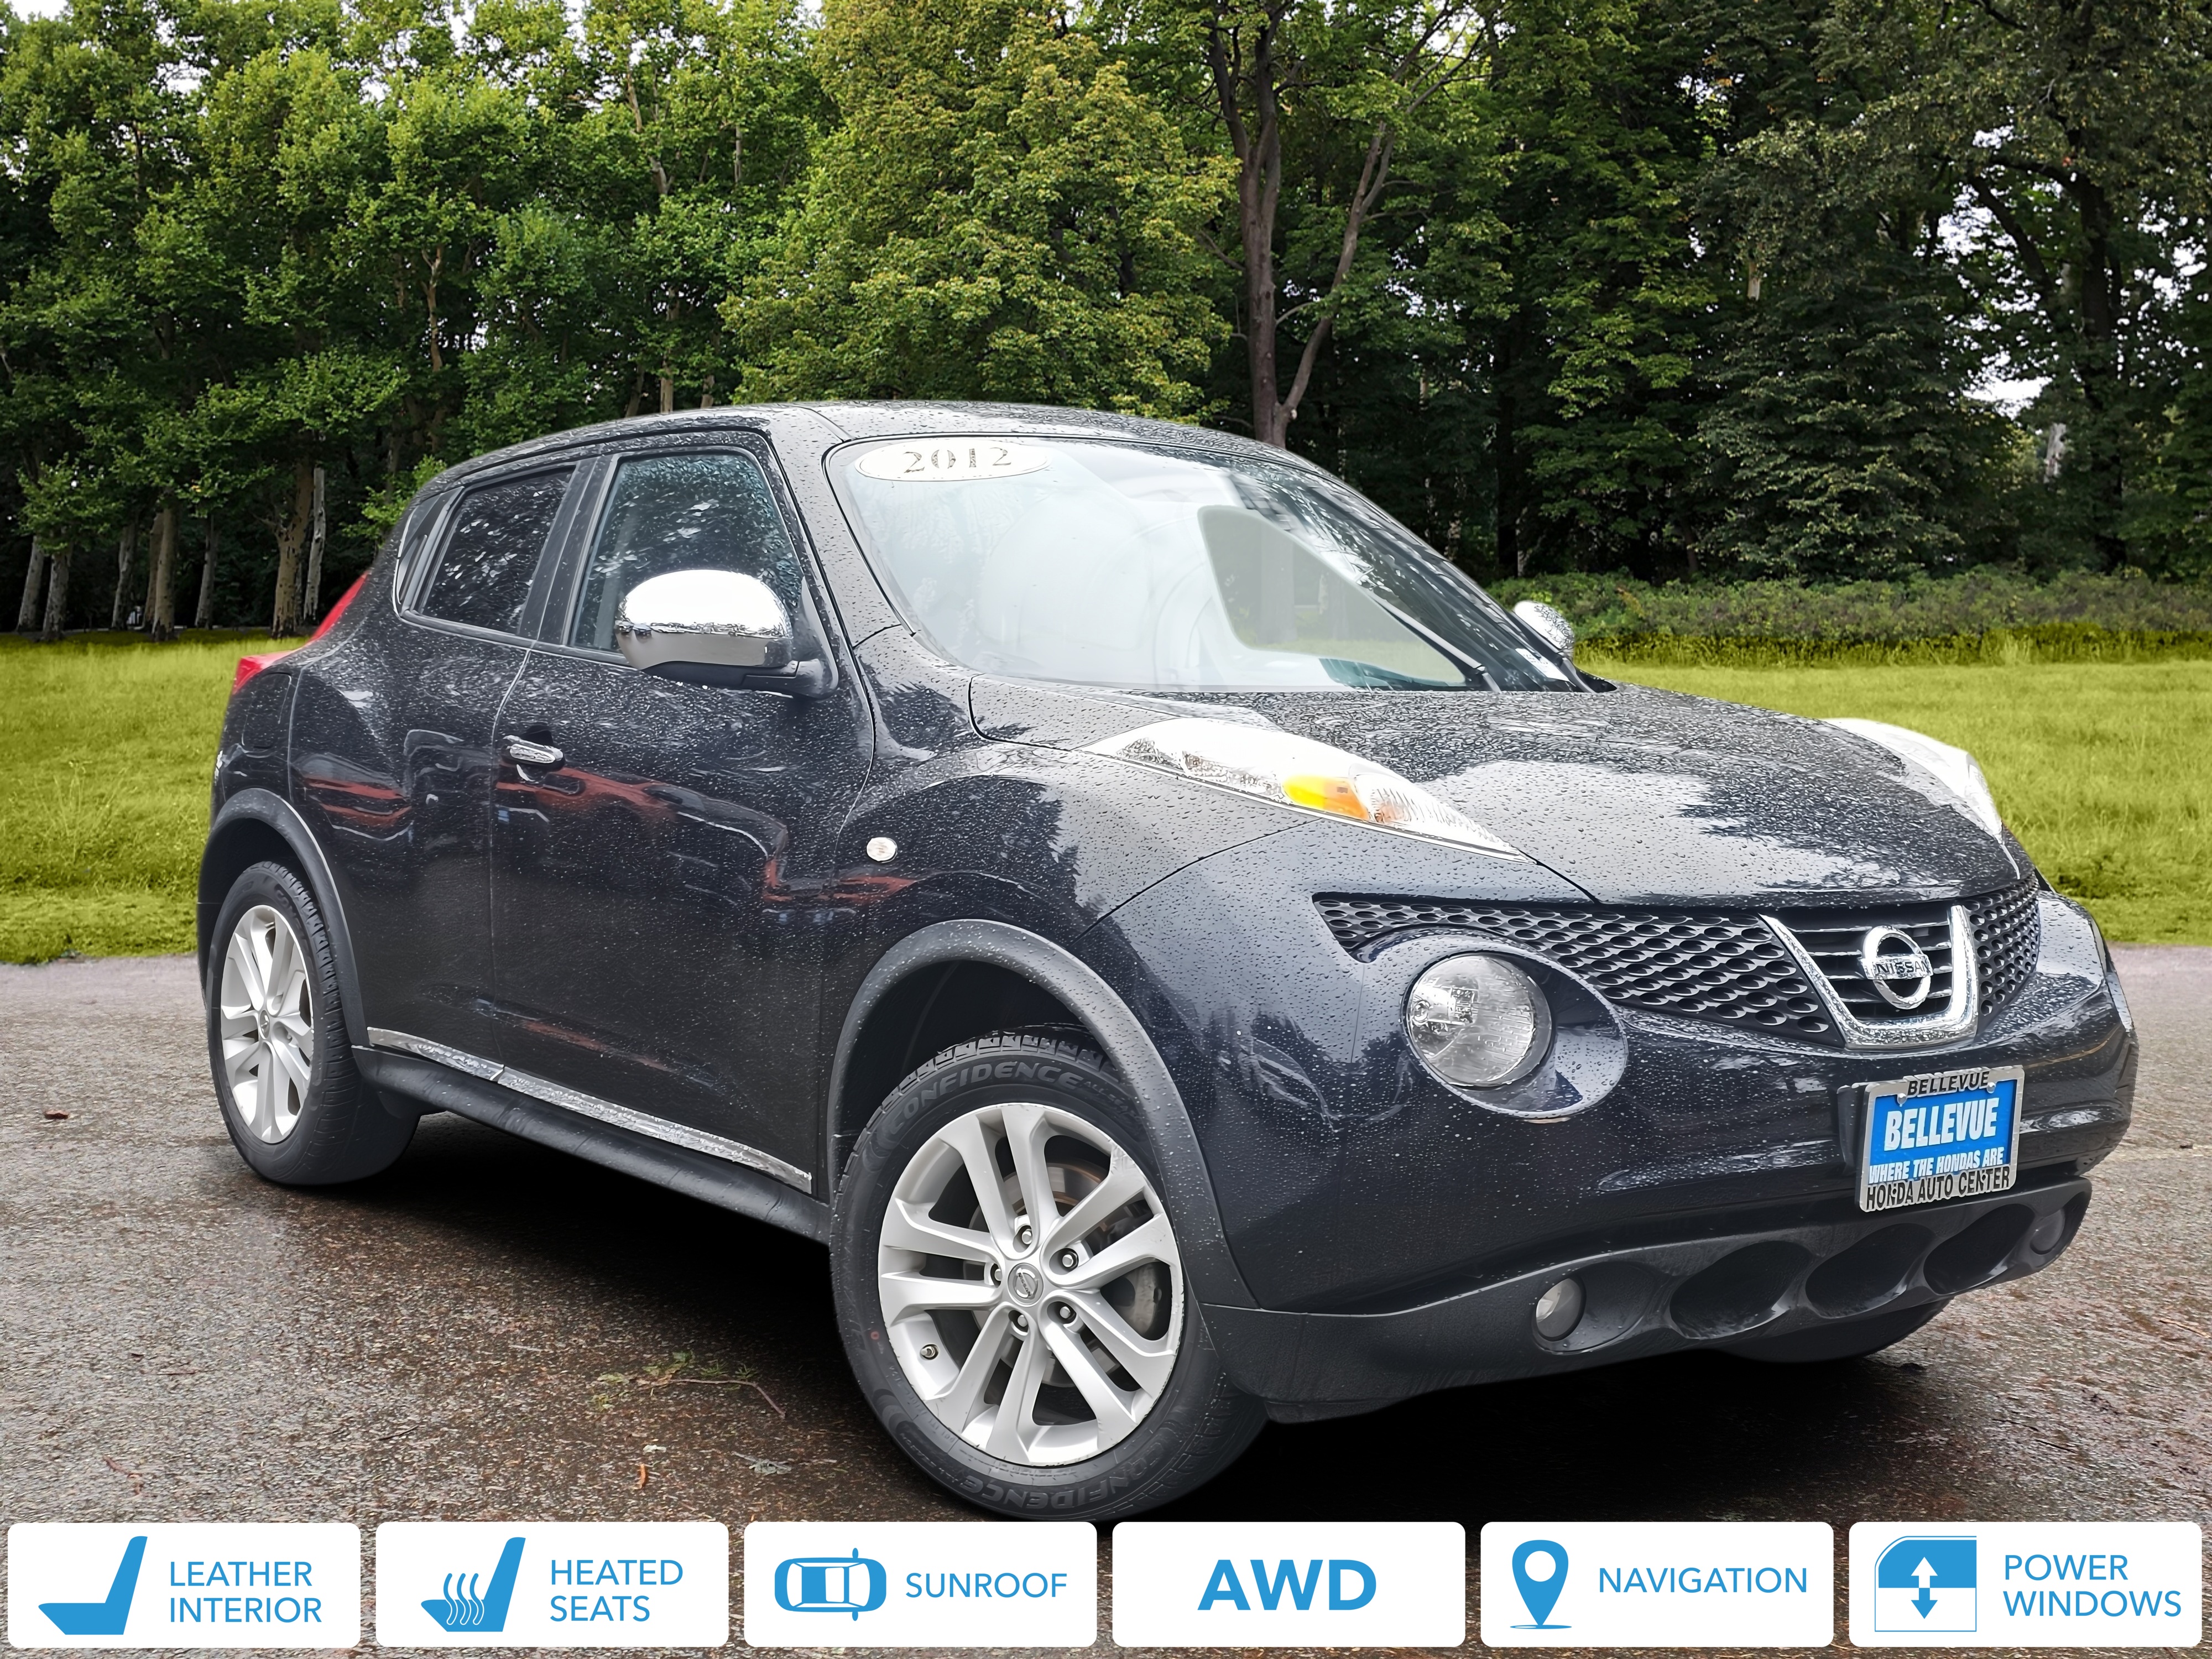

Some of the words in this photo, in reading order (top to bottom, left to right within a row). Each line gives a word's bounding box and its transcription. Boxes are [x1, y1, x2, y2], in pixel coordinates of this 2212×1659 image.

[902, 447, 1012, 473] 2012
[1876, 961, 1931, 975] NISSAN
[889, 1061, 1084, 1135] CONFIDENCE
[1907, 1071, 1990, 1097] BELLEVUE
[1884, 1097, 2000, 1151] BELLEVUE
[1869, 1160, 1911, 1184] WHERE
[1913, 1157, 1934, 1178] THE
[1936, 1150, 1981, 1174] HONDAS
[1981, 1146, 2005, 1167] ARE
[1866, 1181, 1914, 1210] HONDA
[1917, 1174, 1954, 1203] AUTO
[1958, 1167, 2010, 1195] CENTER
